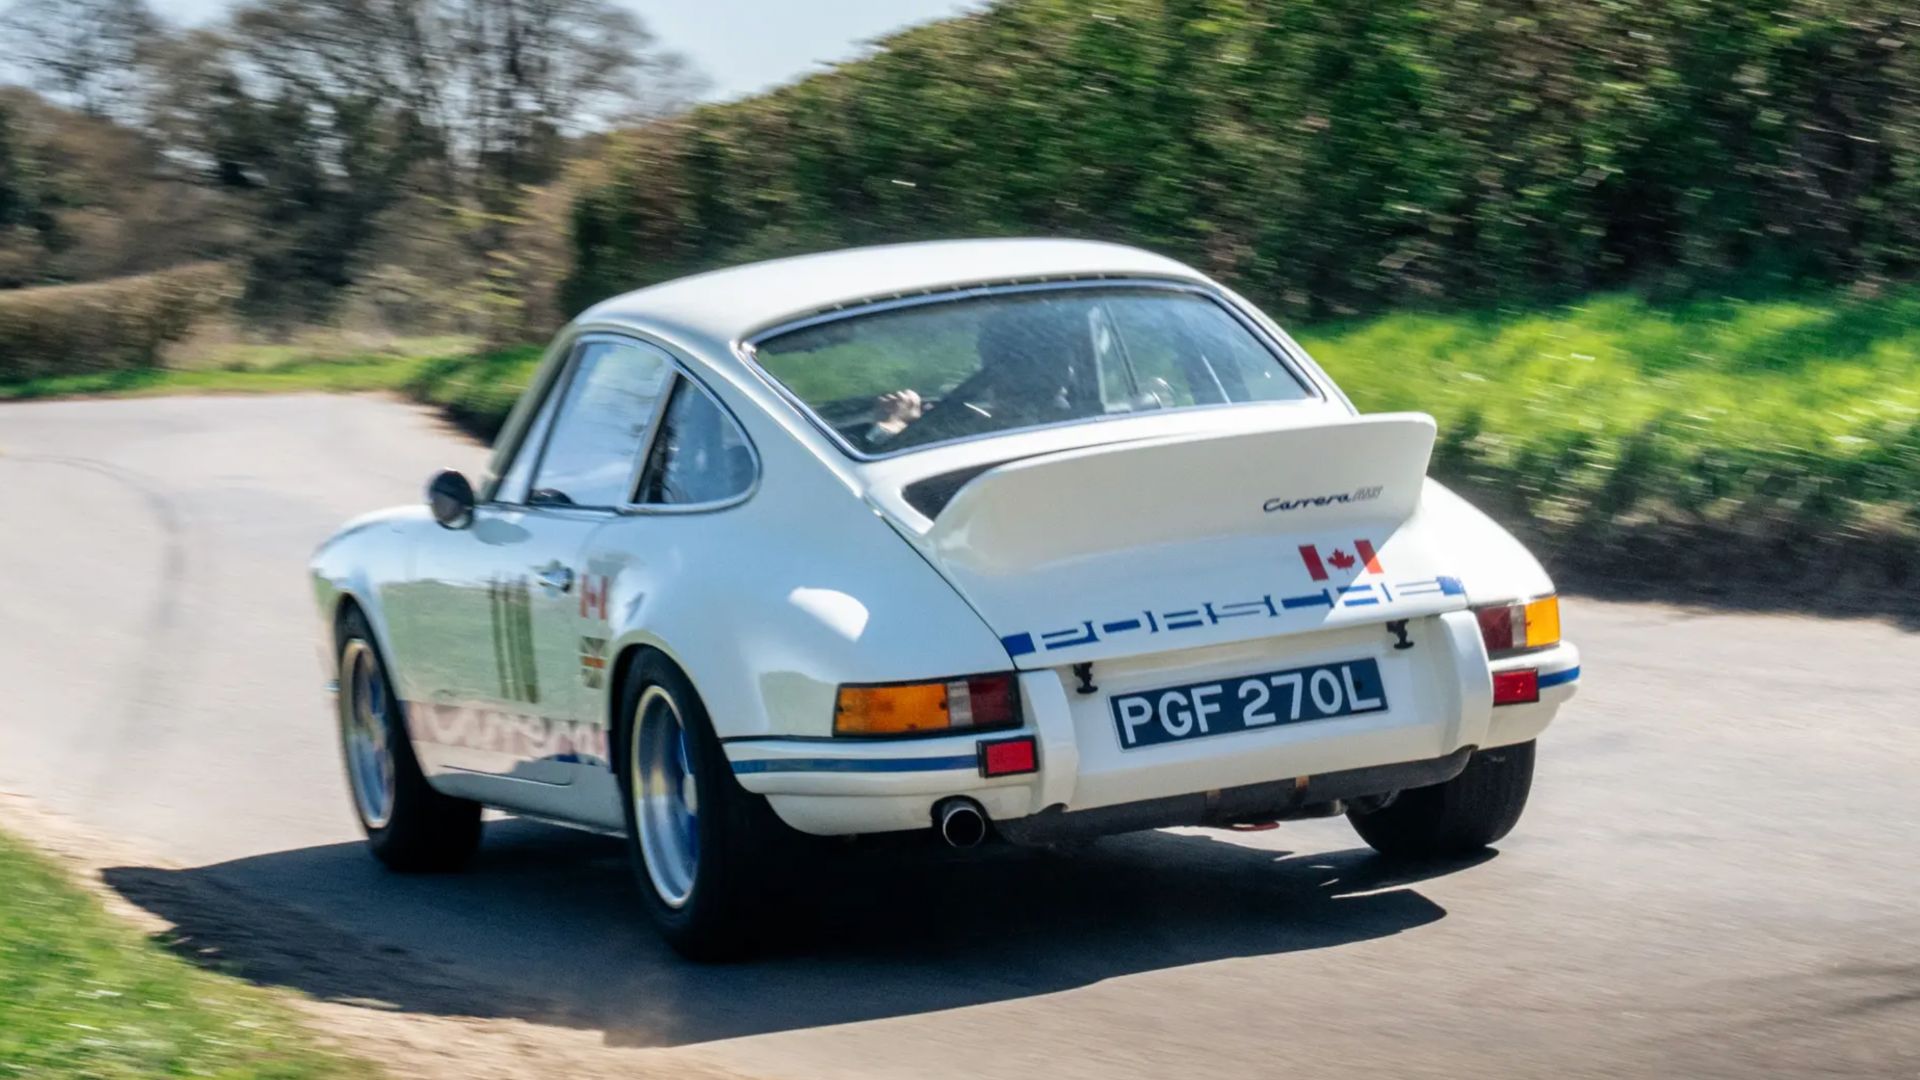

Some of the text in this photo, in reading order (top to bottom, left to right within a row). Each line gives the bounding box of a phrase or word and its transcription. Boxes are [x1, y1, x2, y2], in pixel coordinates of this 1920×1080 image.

[1263, 493, 1351, 513] Carrera
[1032, 577, 1441, 651] PORSCHE
[1117, 665, 1382, 744] PGF 270L
